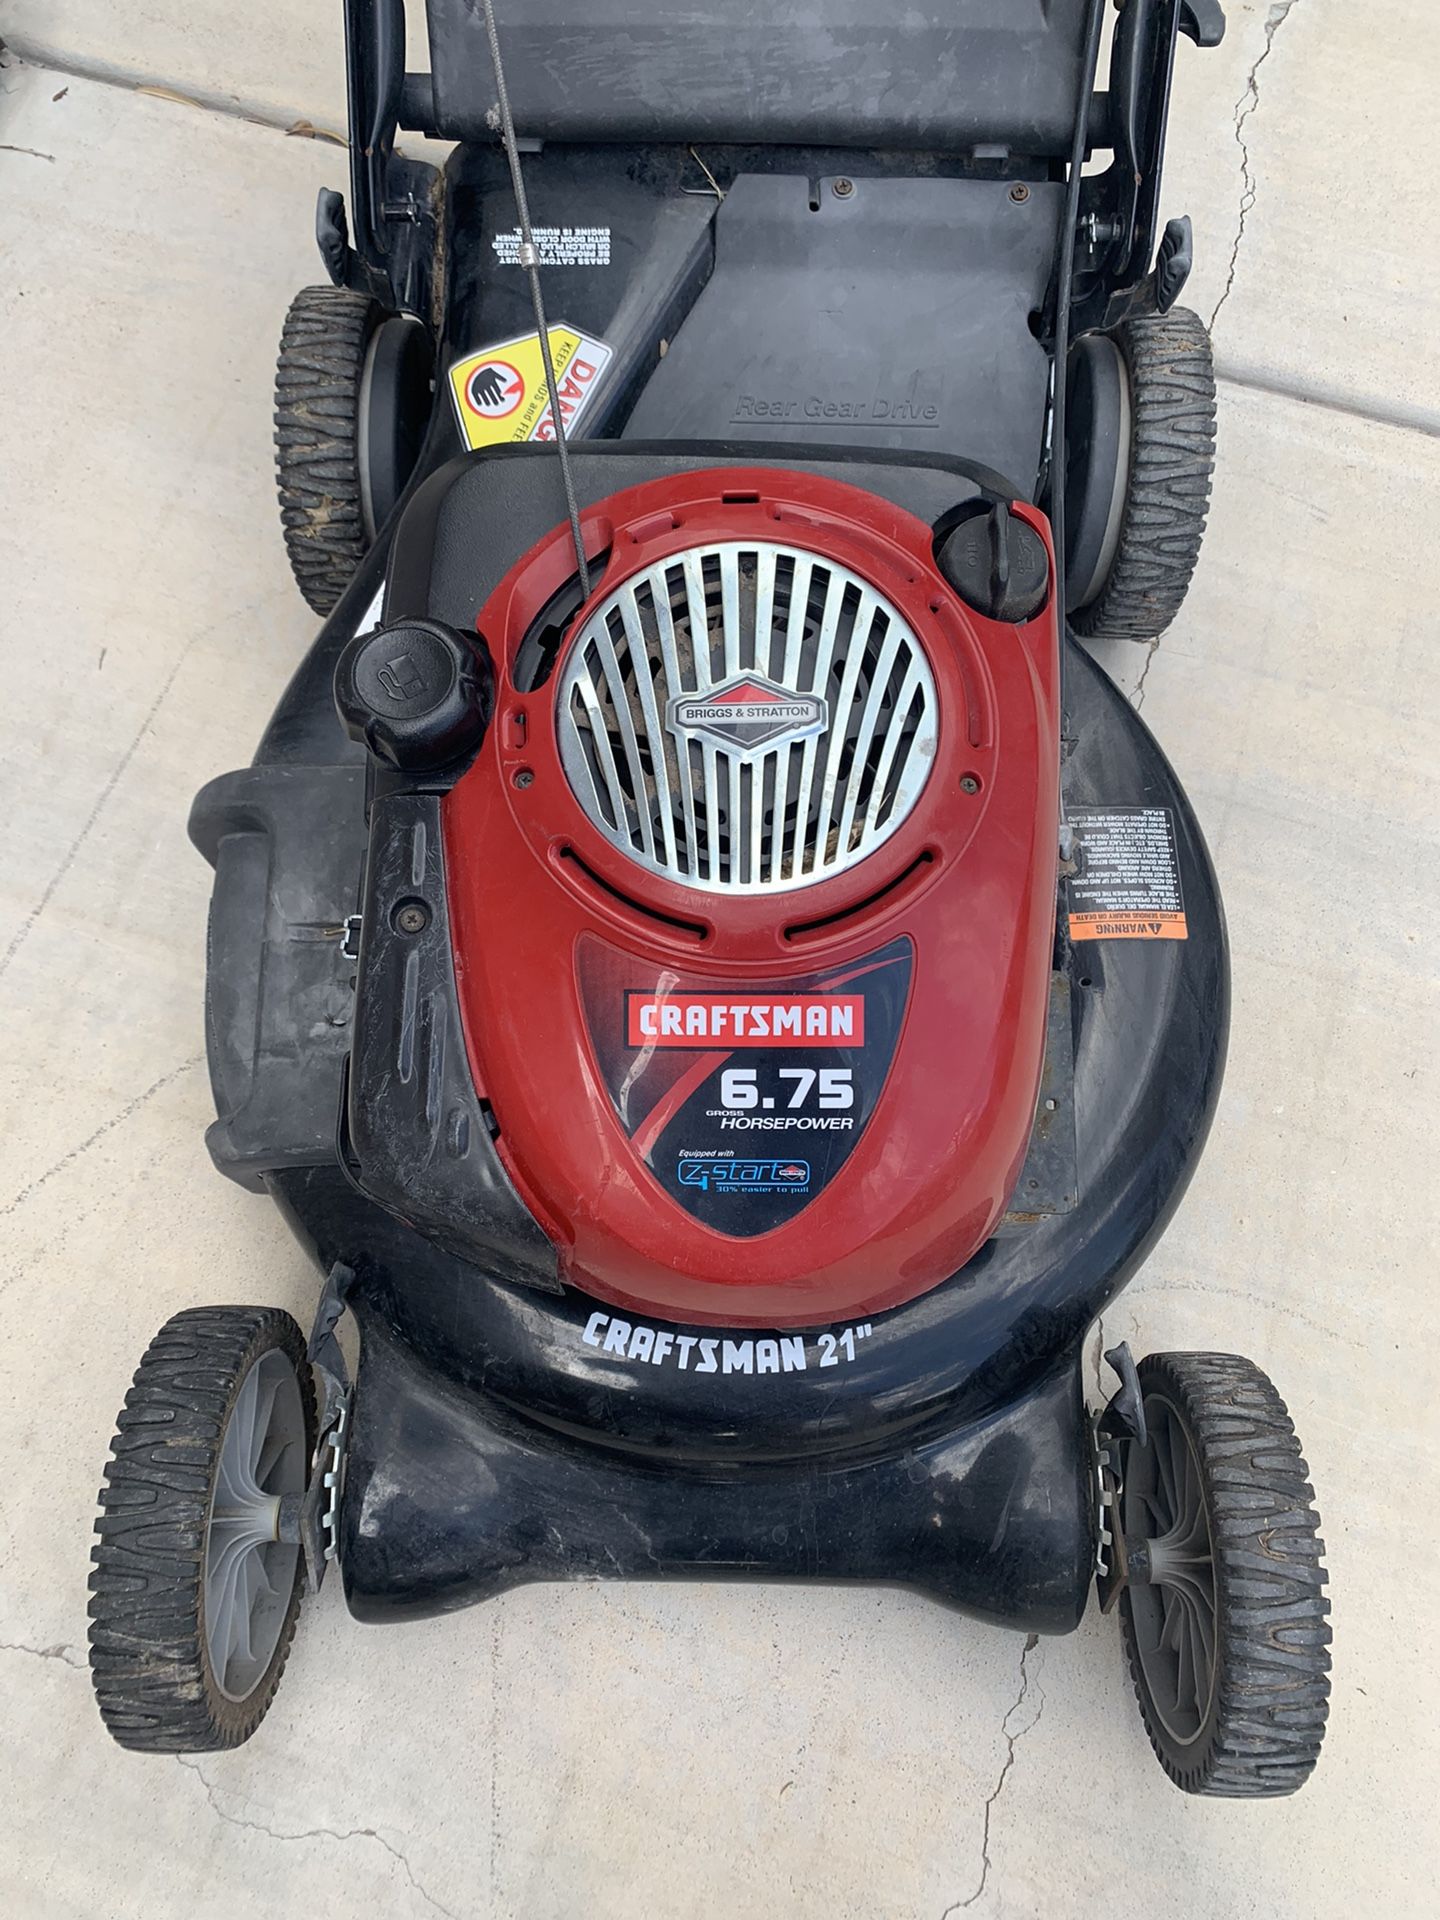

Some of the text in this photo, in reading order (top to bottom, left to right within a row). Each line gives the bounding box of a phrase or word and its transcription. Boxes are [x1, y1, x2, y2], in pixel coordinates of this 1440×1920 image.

[556, 341, 573, 368] KEEP
[524, 402, 538, 422] and
[735, 396, 938, 420] Rear Gear Drive
[686, 706, 809, 719] BRIGGS & STRATTON
[1096, 923, 1147, 934] WARNING
[640, 1004, 854, 1036] CRAFTSMAN
[720, 1068, 854, 1109] 6.75
[720, 1117, 854, 1130] HORSEPOWER
[678, 1149, 717, 1158] Equipped
[790, 1186, 809, 1194] pull
[582, 1311, 872, 1374] CRAFTSMAN 21"
